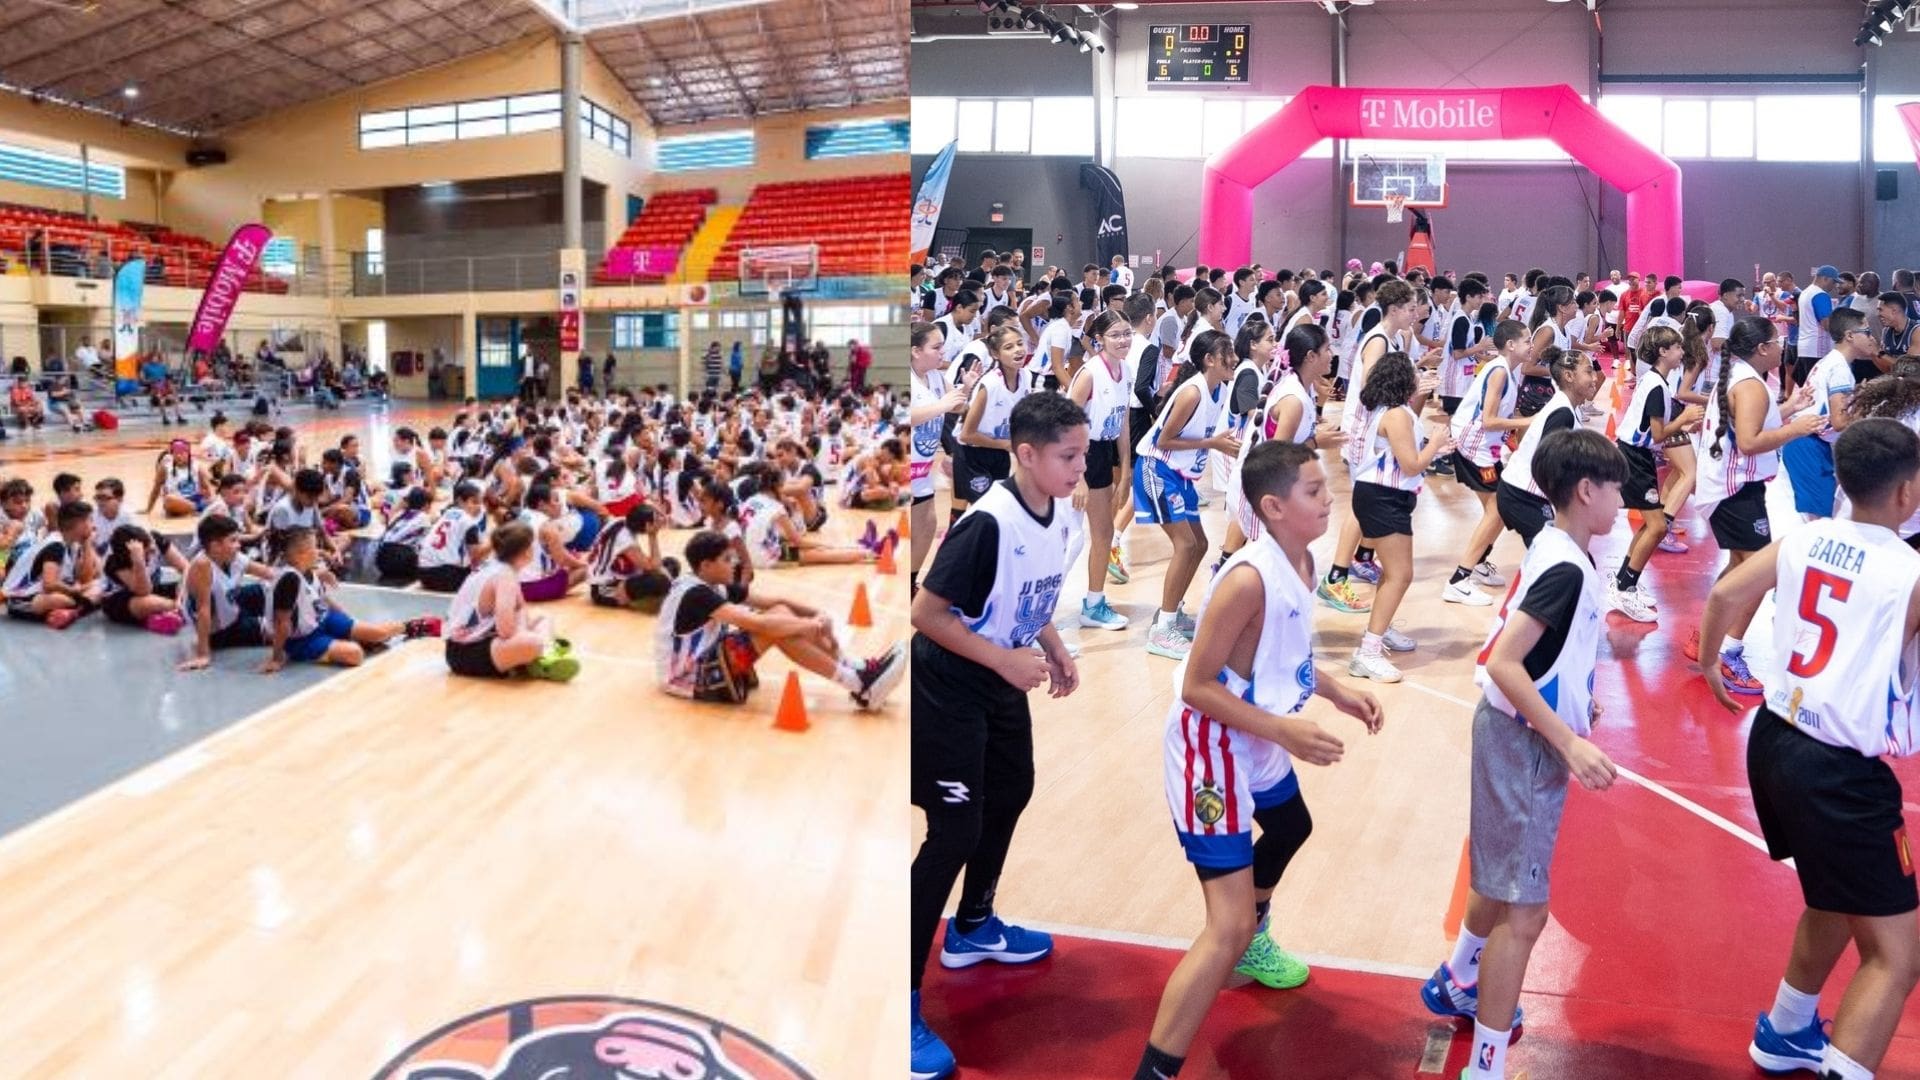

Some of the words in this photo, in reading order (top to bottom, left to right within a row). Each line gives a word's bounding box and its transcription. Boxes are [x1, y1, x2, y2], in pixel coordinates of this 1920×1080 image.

[1190, 26, 1209, 40] 0.0
[1165, 35, 1174, 49] 0
[1235, 35, 1244, 49] 0
[1160, 65, 1168, 75] 6
[1204, 64, 1211, 76] 0
[1230, 65, 1238, 75] 6
[1392, 98, 1494, 128] Mobile
[1098, 215, 1122, 234] AC
[1124, 273, 1131, 287] 5
[197, 257, 248, 334] Mobile
[830, 444, 840, 464] 5
[432, 520, 451, 550] 5
[1808, 537, 1866, 574] BAREA
[1019, 581, 1032, 596] JJ
[1786, 565, 1853, 679] 5
[1797, 706, 1821, 729] 2011
